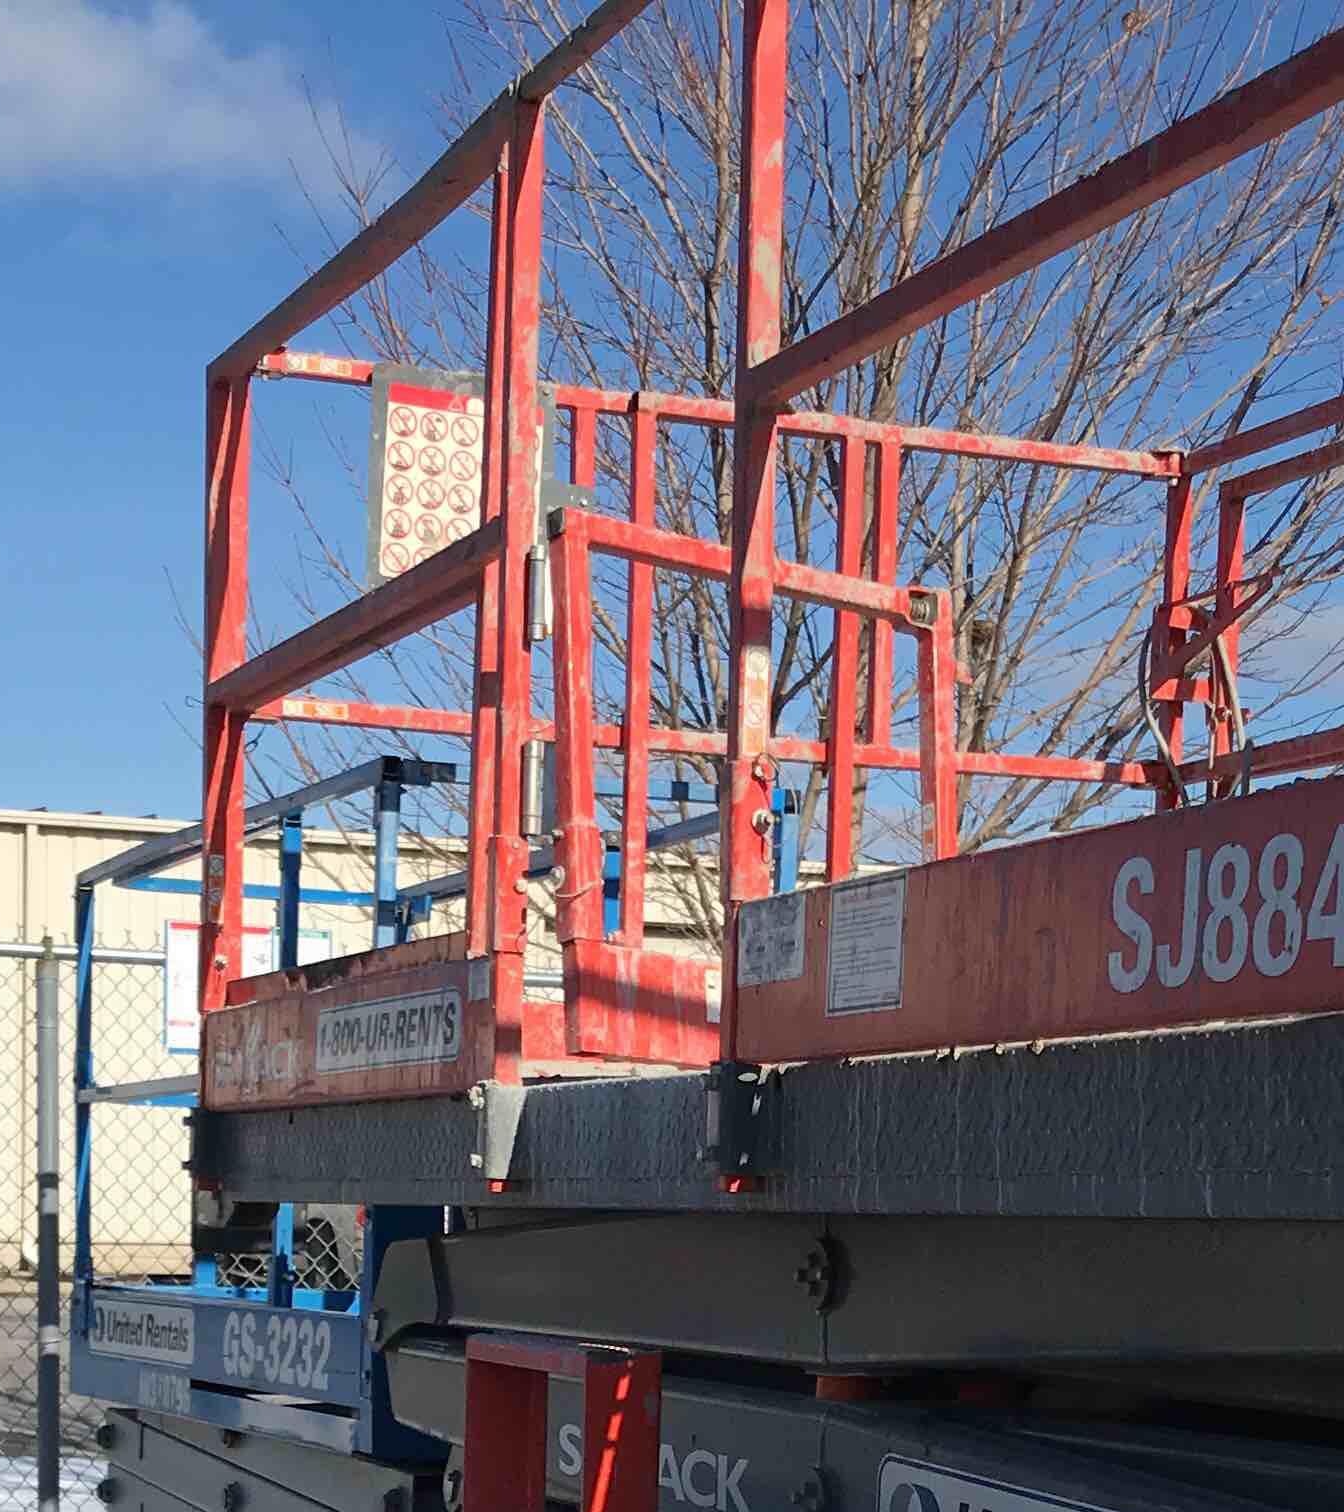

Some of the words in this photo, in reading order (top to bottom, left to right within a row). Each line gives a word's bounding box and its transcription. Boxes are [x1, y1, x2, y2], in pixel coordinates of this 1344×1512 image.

[319, 1001, 457, 1057] 1-800-UR-RENTS
[107, 1311, 144, 1346] United
[145, 1313, 189, 1353] Rentals
[223, 1310, 331, 1391] GS-3232
